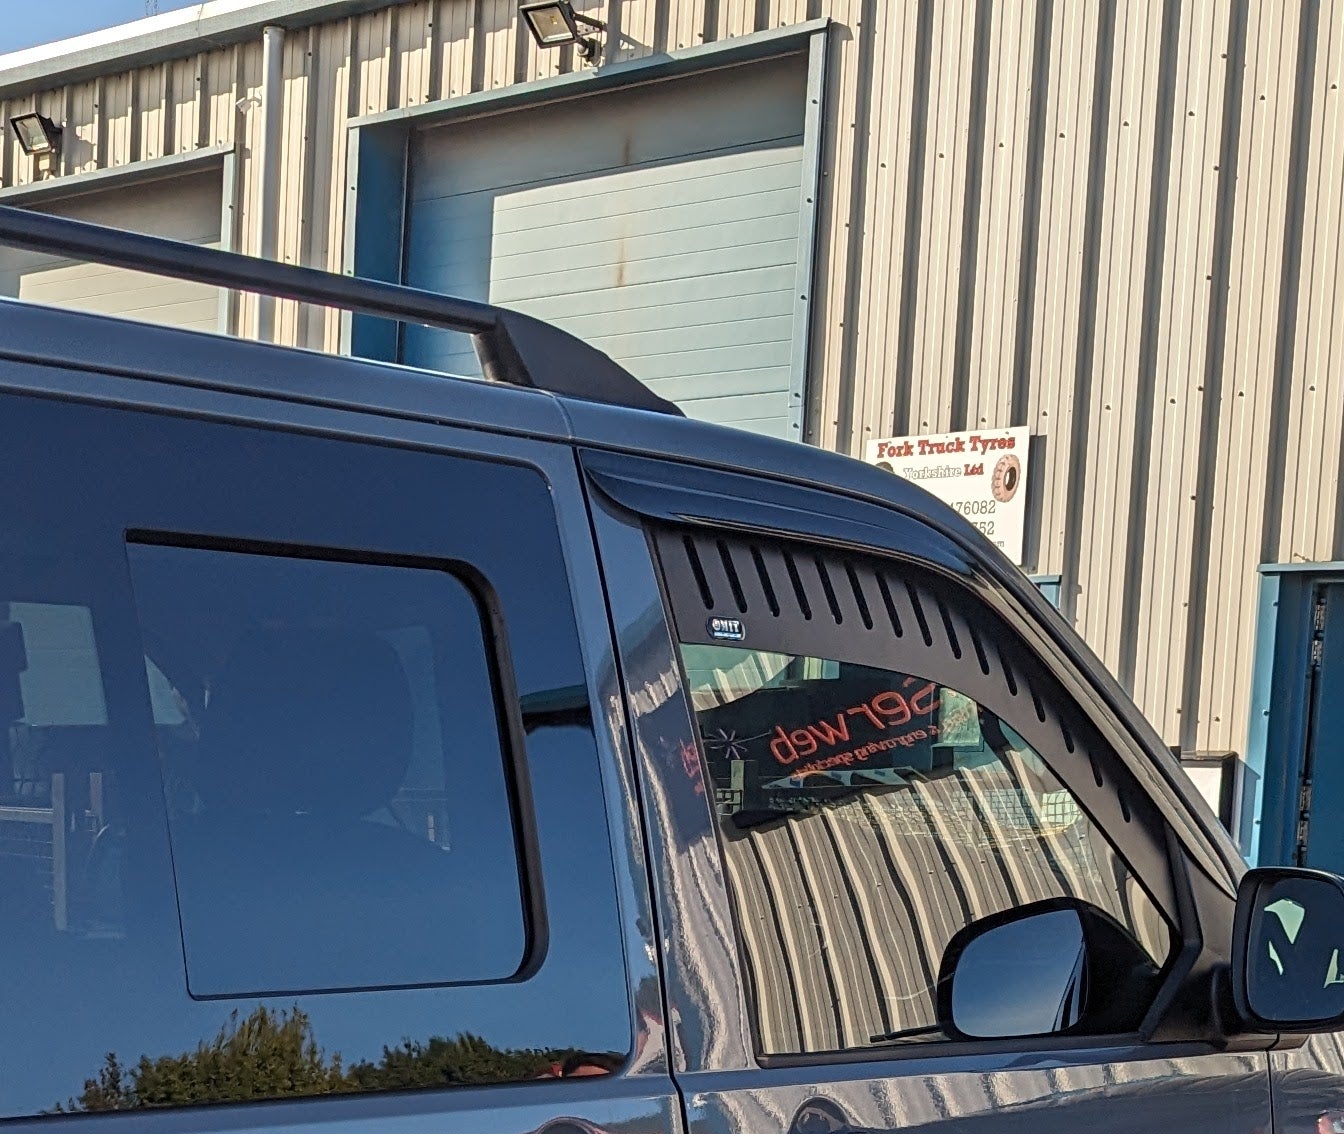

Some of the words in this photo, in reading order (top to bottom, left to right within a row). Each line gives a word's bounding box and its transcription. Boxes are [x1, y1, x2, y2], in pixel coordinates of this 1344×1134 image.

[877, 441, 914, 458] Fork
[918, 437, 965, 455] Truck
[969, 435, 1016, 455] Tyres
[903, 465, 961, 480] Yorkshire
[964, 463, 984, 476] Ltd
